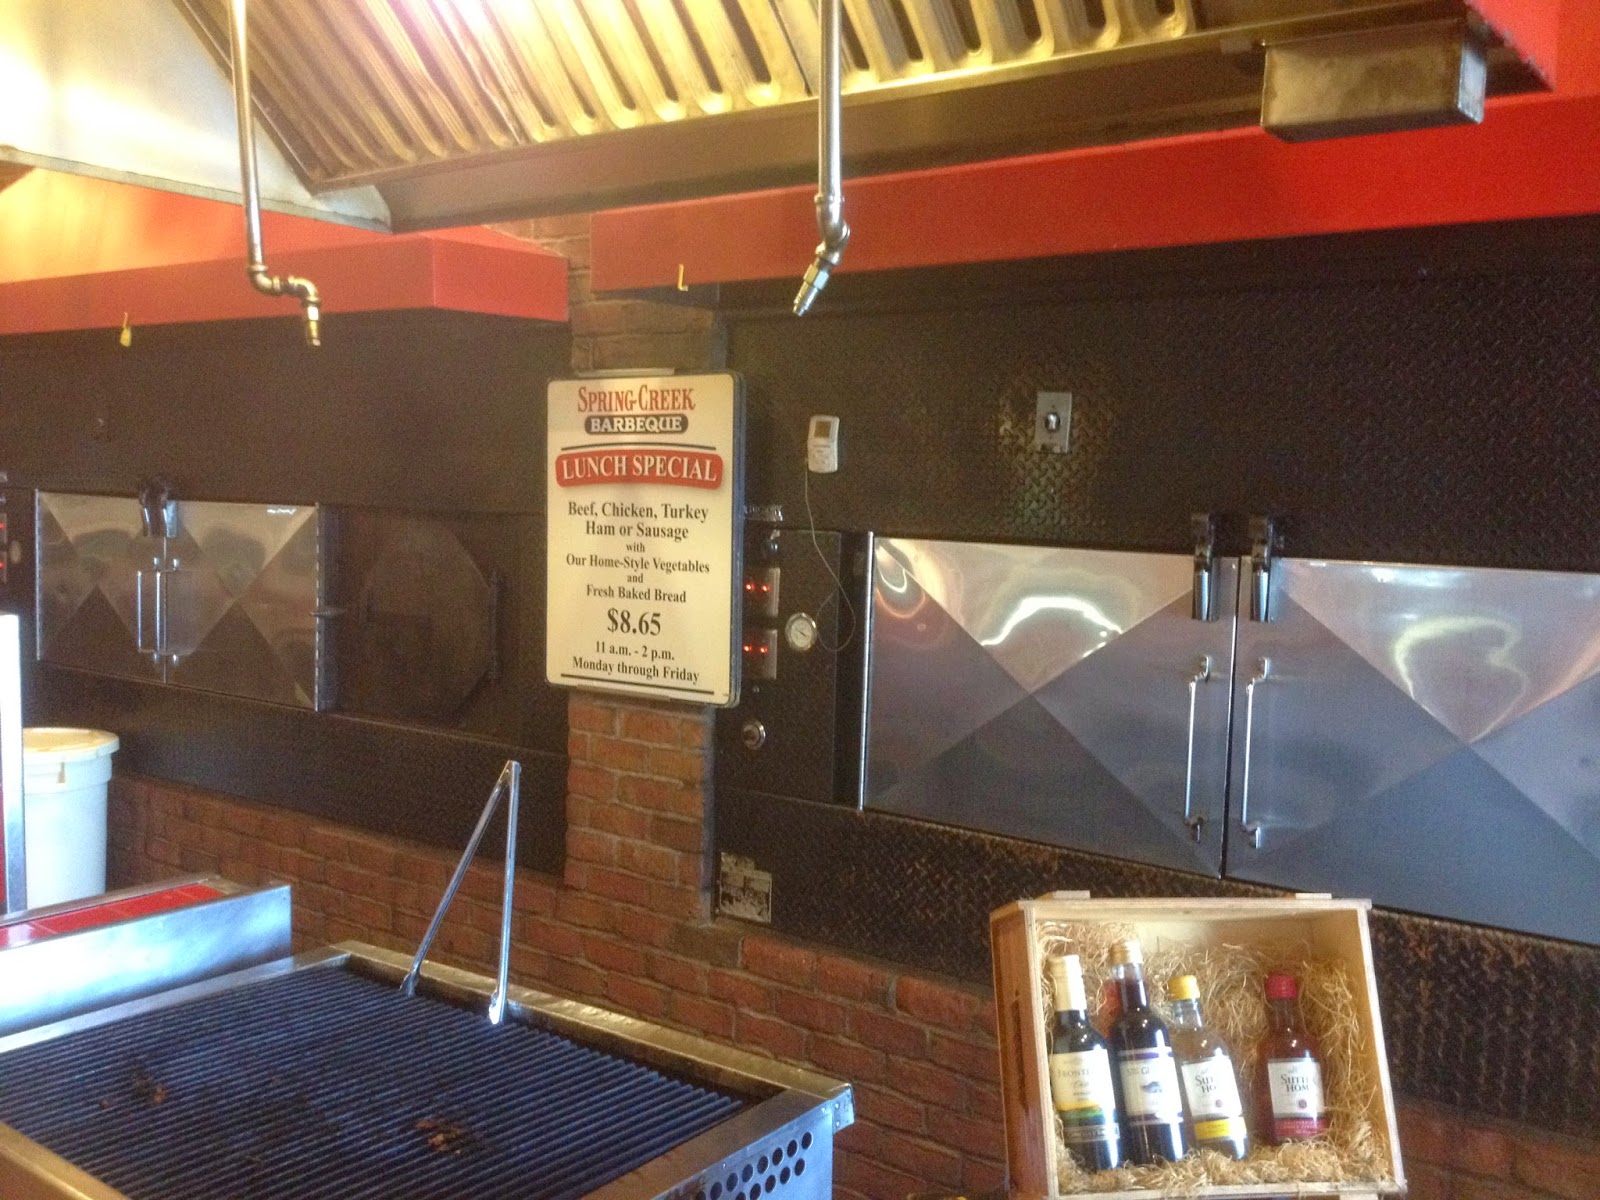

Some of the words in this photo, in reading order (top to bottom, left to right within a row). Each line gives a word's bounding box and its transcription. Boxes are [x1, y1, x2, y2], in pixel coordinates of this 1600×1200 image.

[578, 386, 636, 412] SPRING
[639, 384, 696, 411] CREEK
[590, 416, 682, 433] BARBEQUE
[562, 455, 627, 480] LUNCH
[633, 454, 717, 482] SPECIAL
[568, 501, 598, 517] Beef,
[601, 502, 658, 519] Chicken,
[661, 503, 709, 523] Turkey
[586, 520, 615, 536] Ham
[619, 525, 633, 536] or
[636, 522, 689, 542] Sausage
[626, 542, 645, 553] with
[566, 552, 588, 567] Our
[590, 554, 650, 572] Home-Style
[652, 557, 710, 575] Vegetables
[627, 573, 644, 583] and
[586, 584, 614, 599] Fresh
[618, 586, 651, 601] Baked
[654, 588, 687, 603] Bread
[607, 607, 661, 636] $8.65
[595, 640, 605, 654] 11
[609, 645, 632, 656] a.m.
[642, 645, 648, 658] 2
[651, 649, 675, 662] p.m.
[573, 656, 615, 675] Monday
[617, 662, 659, 680] through
[663, 666, 700, 685] Friday
